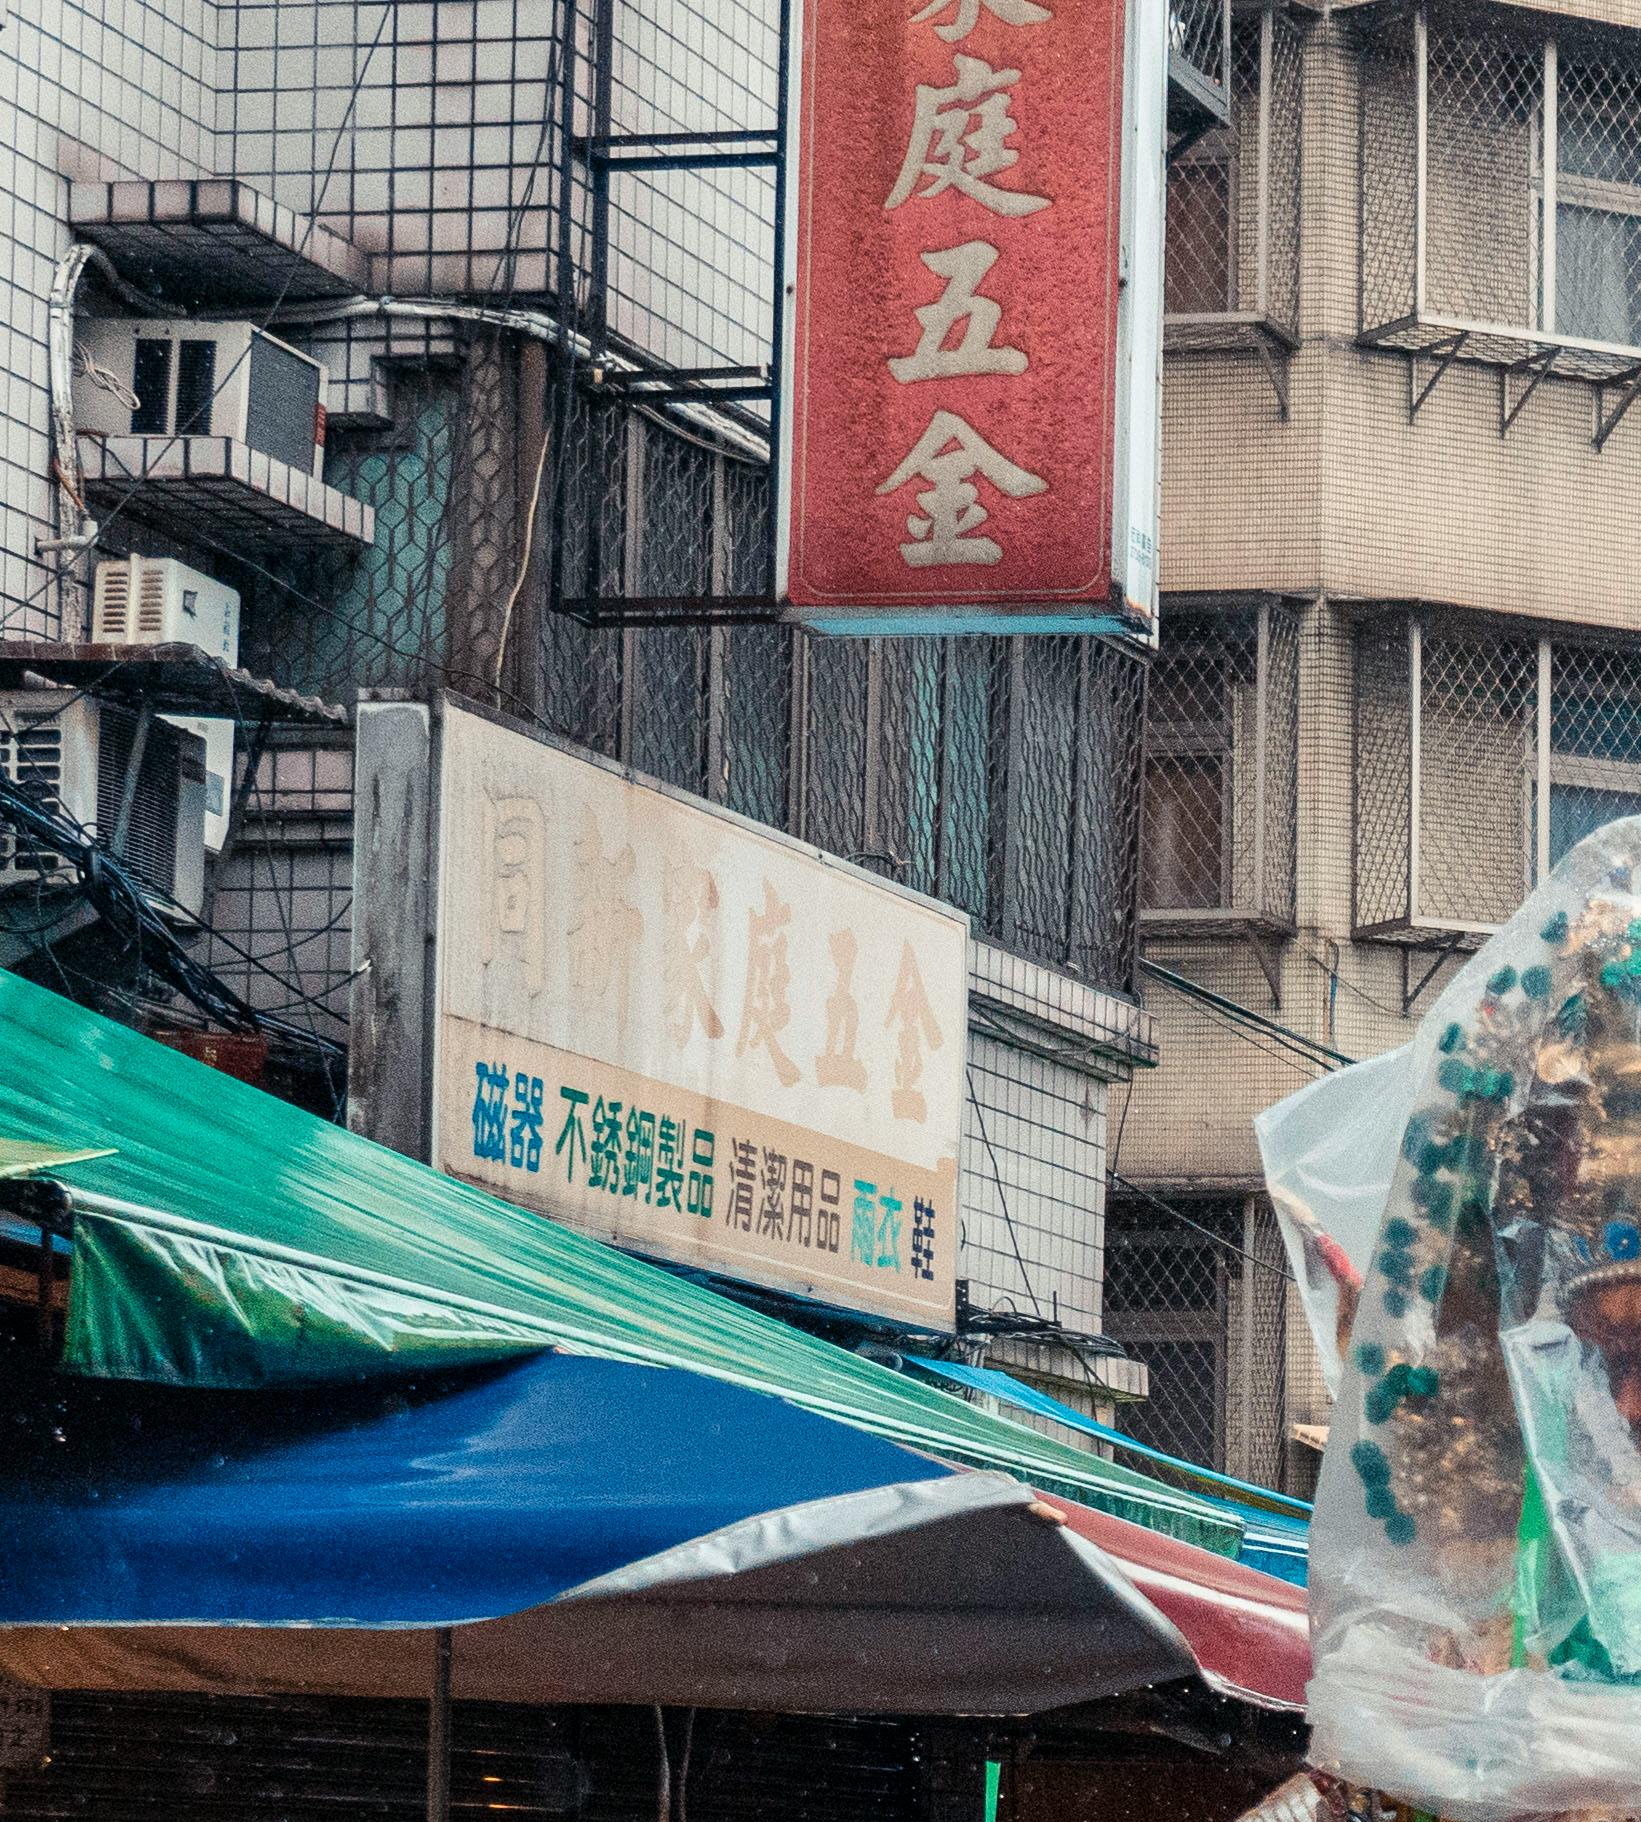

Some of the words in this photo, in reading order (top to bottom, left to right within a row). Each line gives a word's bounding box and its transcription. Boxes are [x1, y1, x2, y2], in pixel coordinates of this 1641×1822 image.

[470, 1063, 545, 1173] 磁器
[556, 1086, 715, 1219] 不銹鋼製品
[726, 1138, 841, 1254] 清潔用品
[910, 1196, 936, 1281] 鞋
